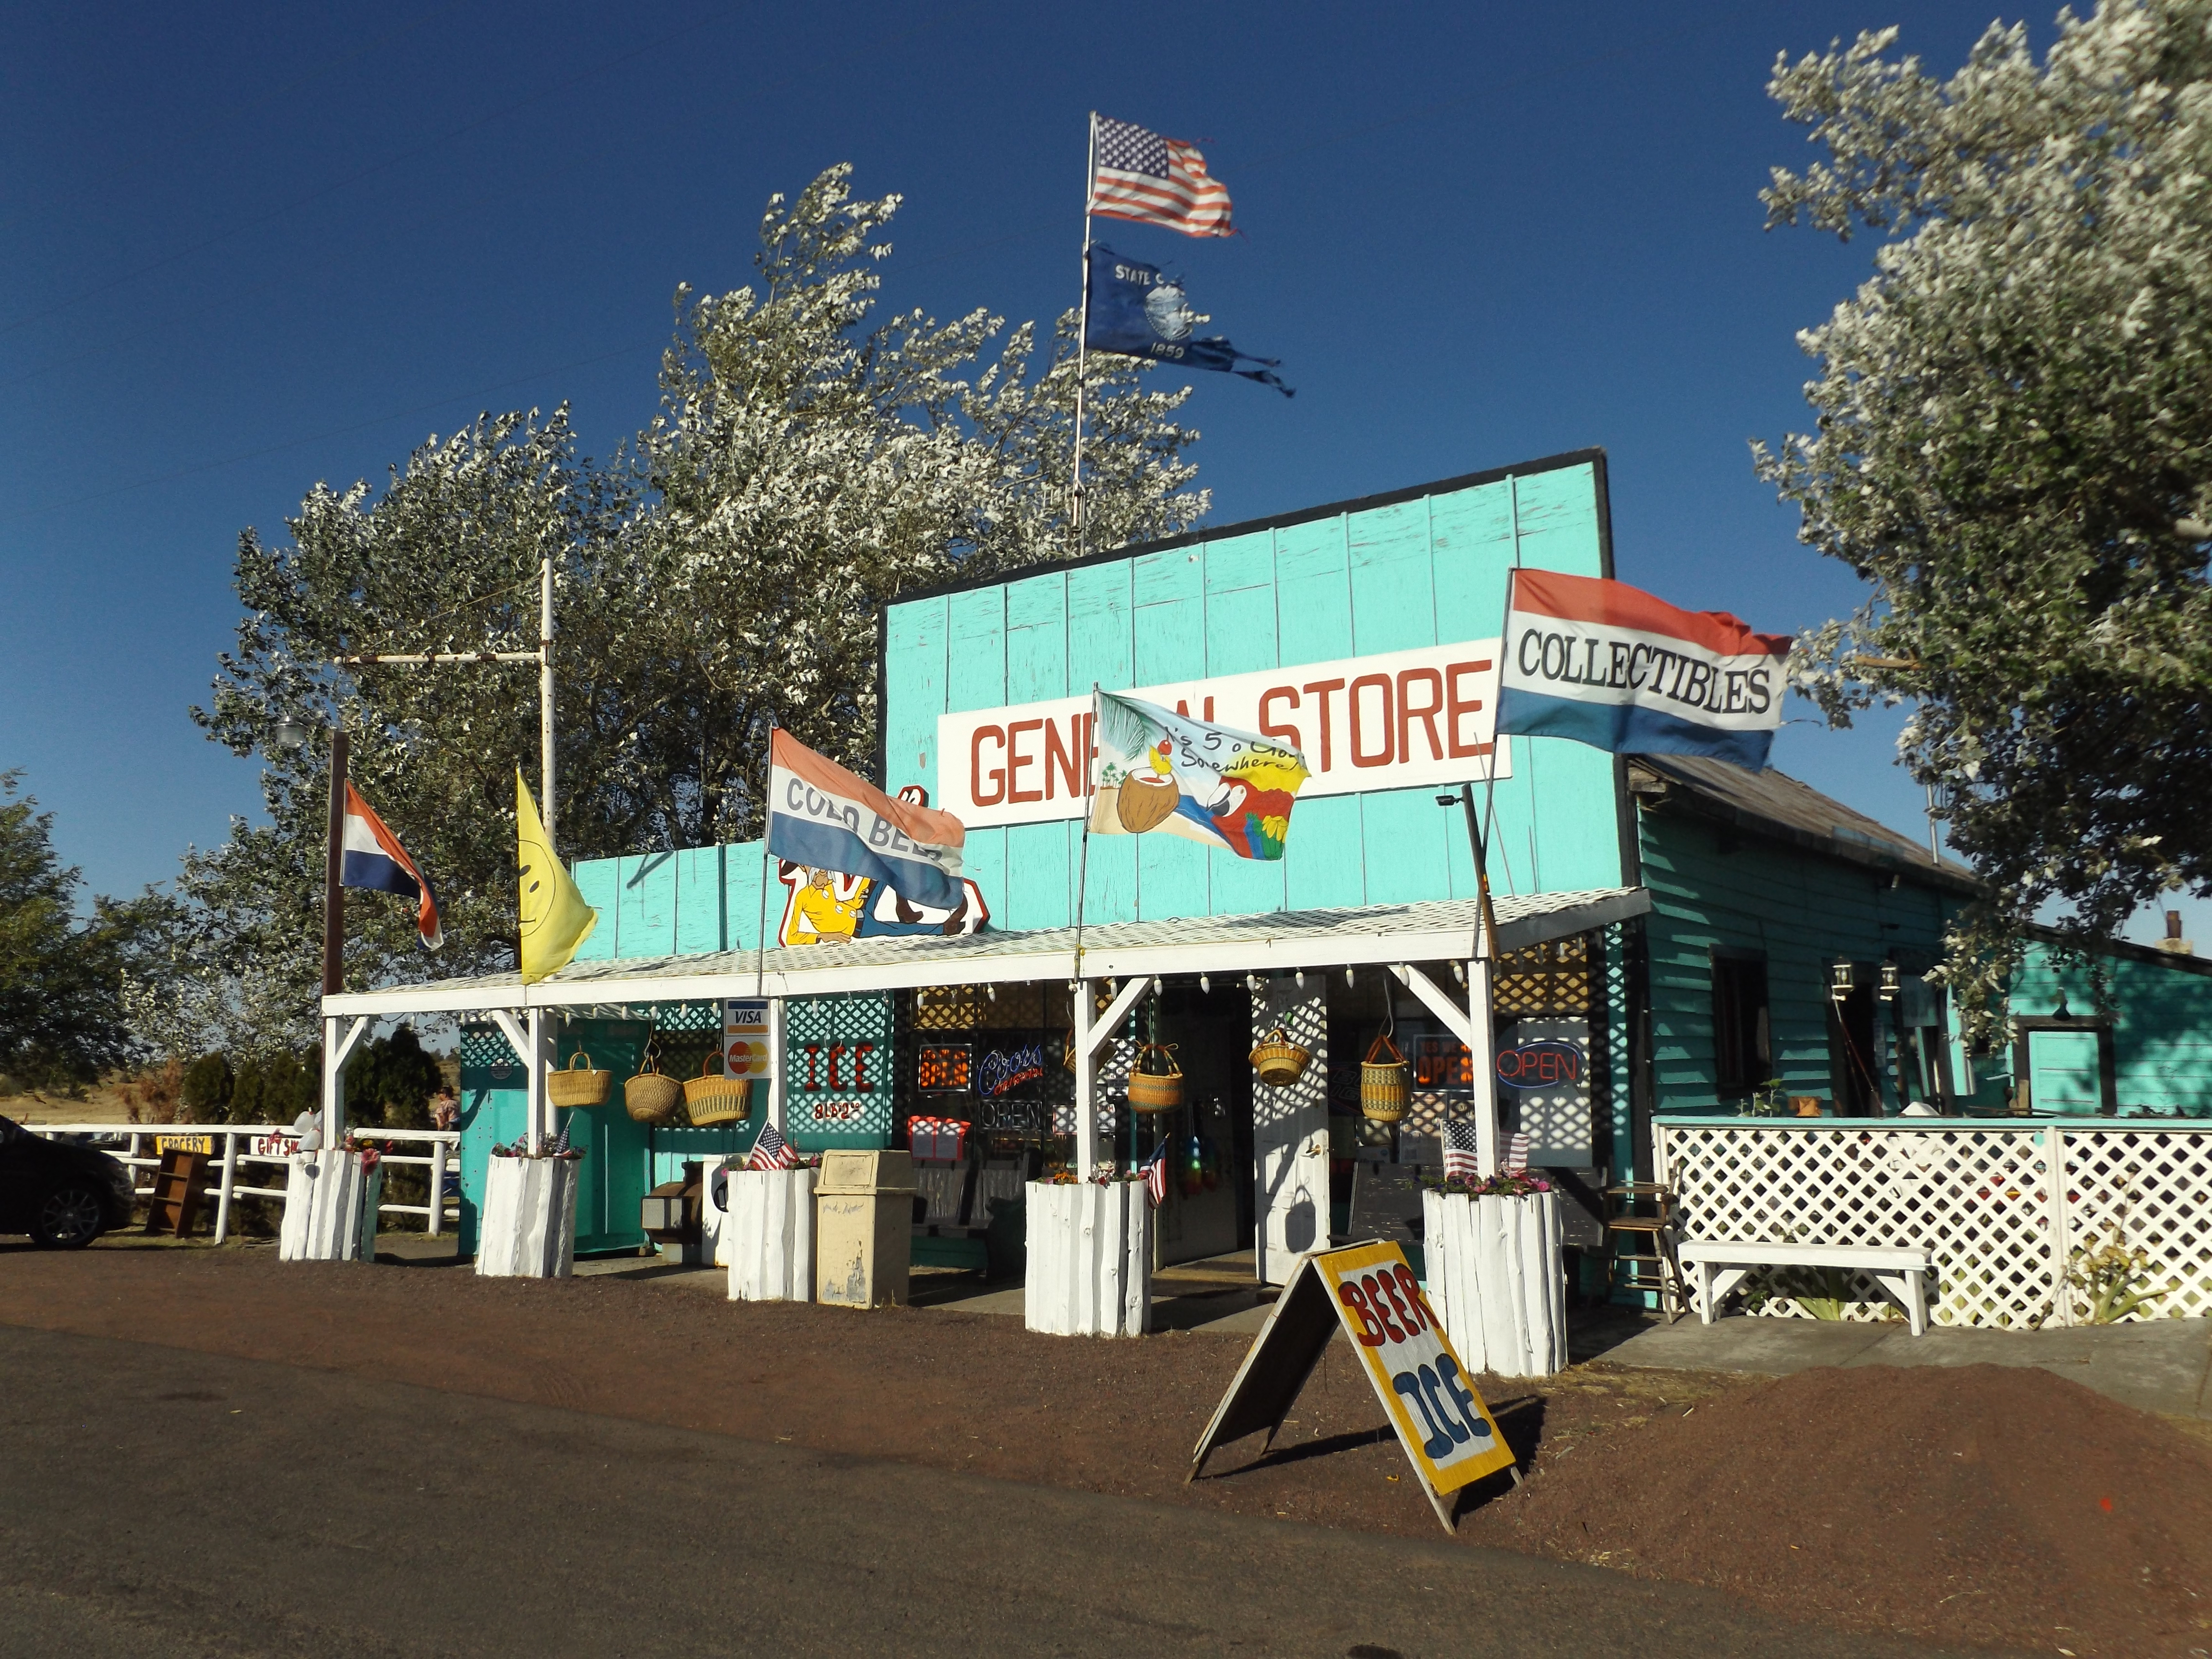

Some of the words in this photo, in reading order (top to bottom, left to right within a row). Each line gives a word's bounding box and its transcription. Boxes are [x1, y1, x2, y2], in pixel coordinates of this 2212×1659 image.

[1115, 264, 1151, 286] STATE
[1151, 342, 1185, 359] 1859
[1518, 628, 1771, 714] COLLECTIBLES
[971, 696, 1214, 807] GENE
[1259, 659, 1494, 773] STORE
[1202, 731, 1223, 751] 5
[786, 777, 860, 834] COLD
[735, 1010, 762, 1024] VISA
[729, 1053, 768, 1063] MasterCard
[805, 1041, 875, 1093] ICE
[978, 1044, 1042, 1095] Coors
[1418, 1056, 1473, 1084] OPEN
[1496, 1050, 1576, 1080] OPEN
[982, 1103, 1041, 1128] OPEN
[258, 1138, 281, 1156] GIFT
[1338, 1263, 1440, 1347] BEER
[1393, 1353, 1491, 1459] ICE
